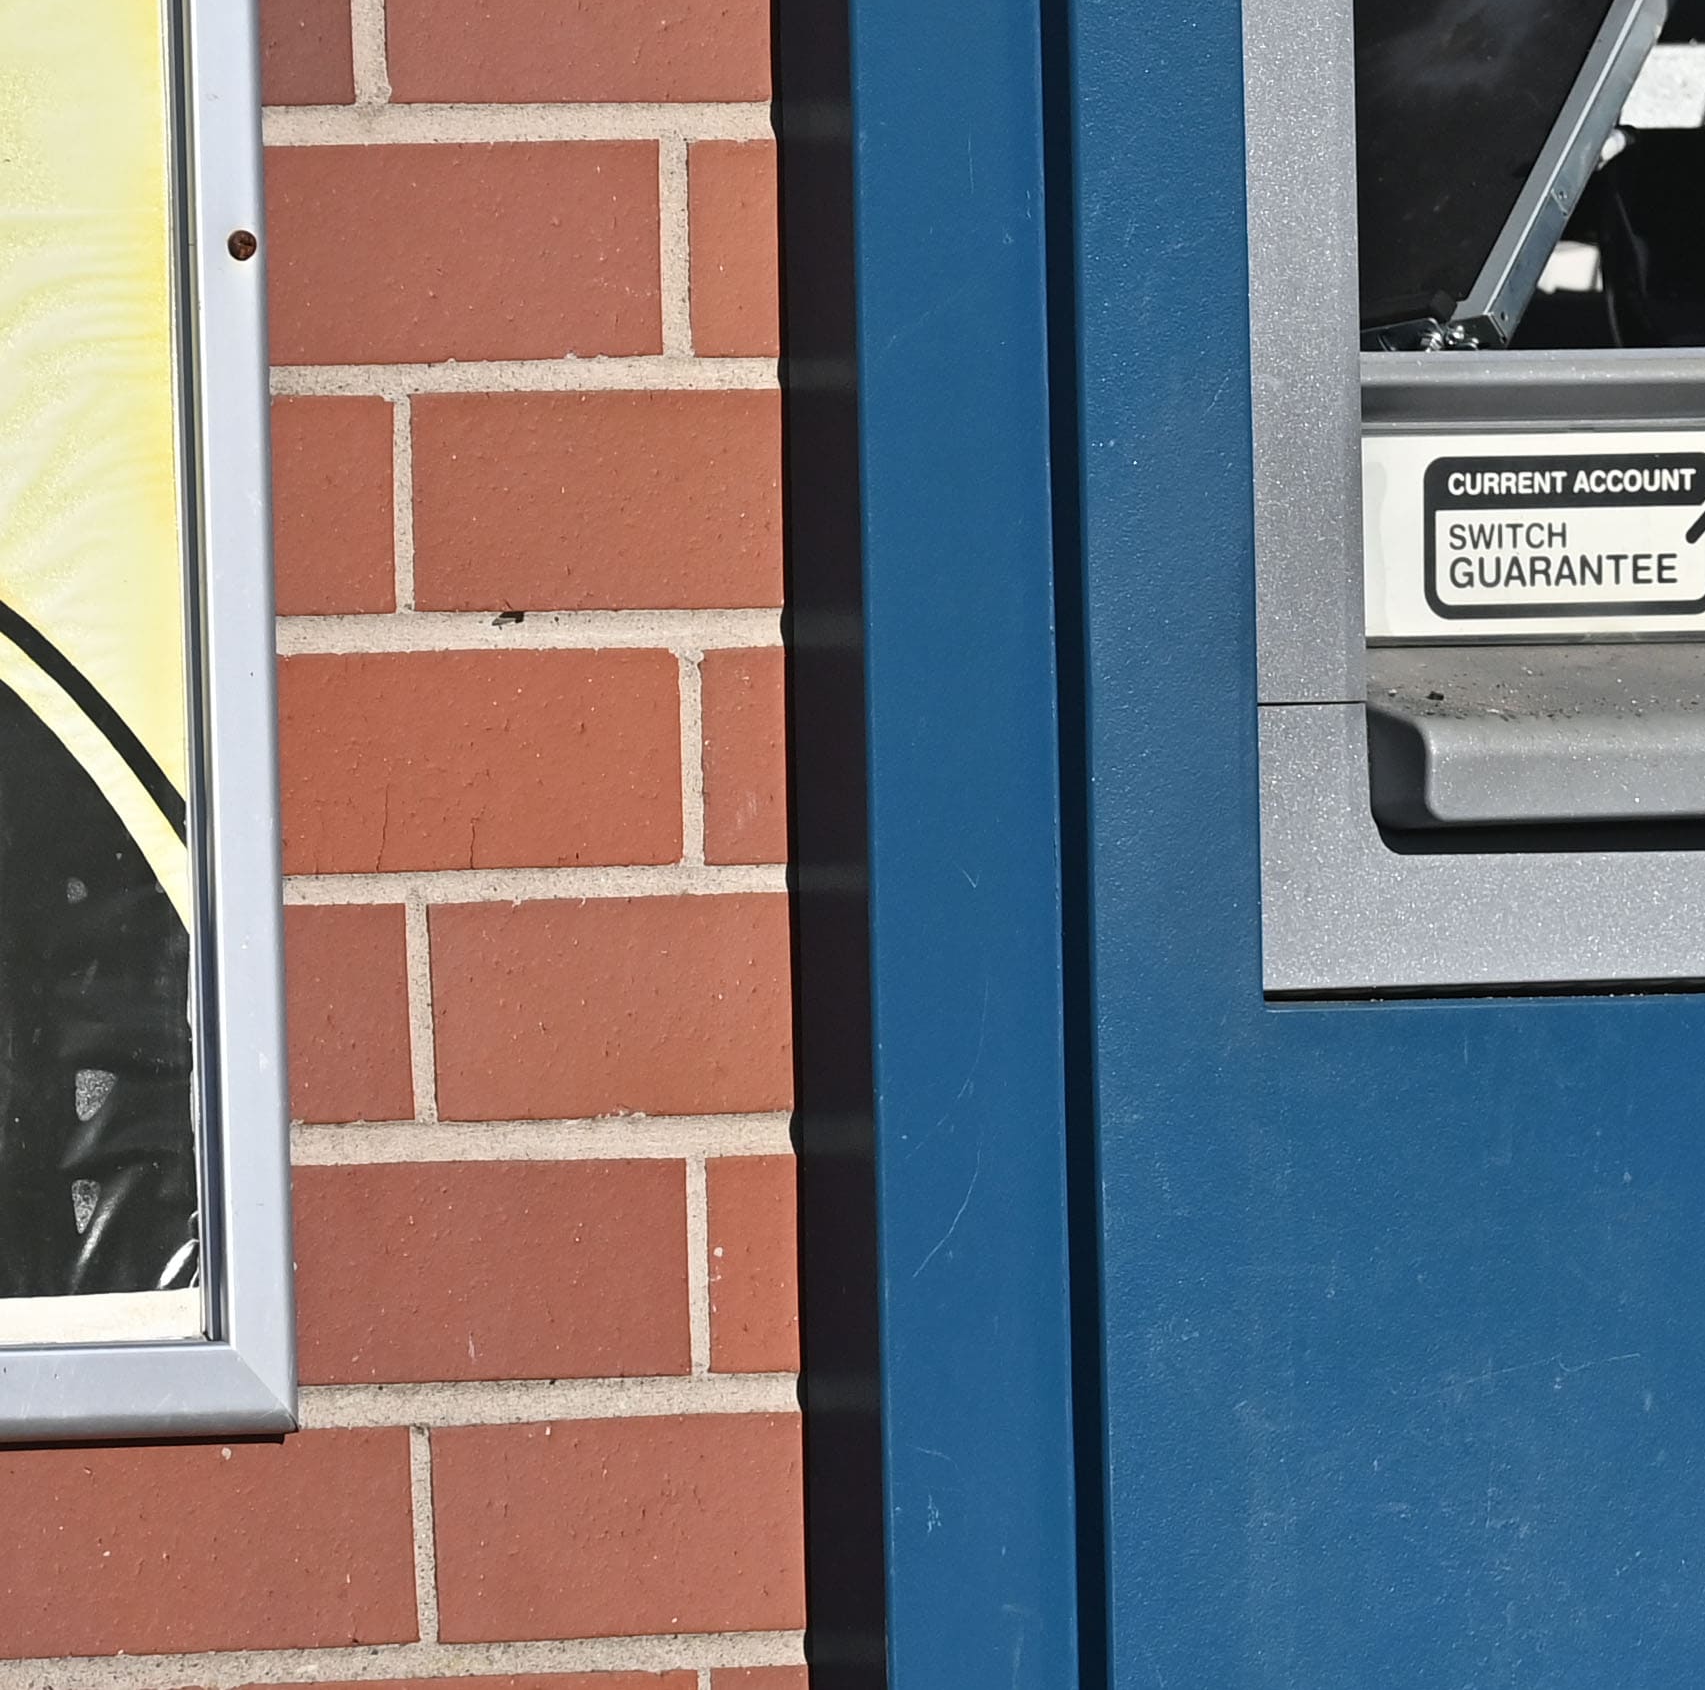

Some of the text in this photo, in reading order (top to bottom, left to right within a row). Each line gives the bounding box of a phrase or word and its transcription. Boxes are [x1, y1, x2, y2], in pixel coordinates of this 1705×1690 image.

[1447, 467, 1697, 497] CURRENT ACCOUNT
[1448, 522, 1567, 551] SWITCH
[1448, 552, 1679, 589] GUARANTEE
